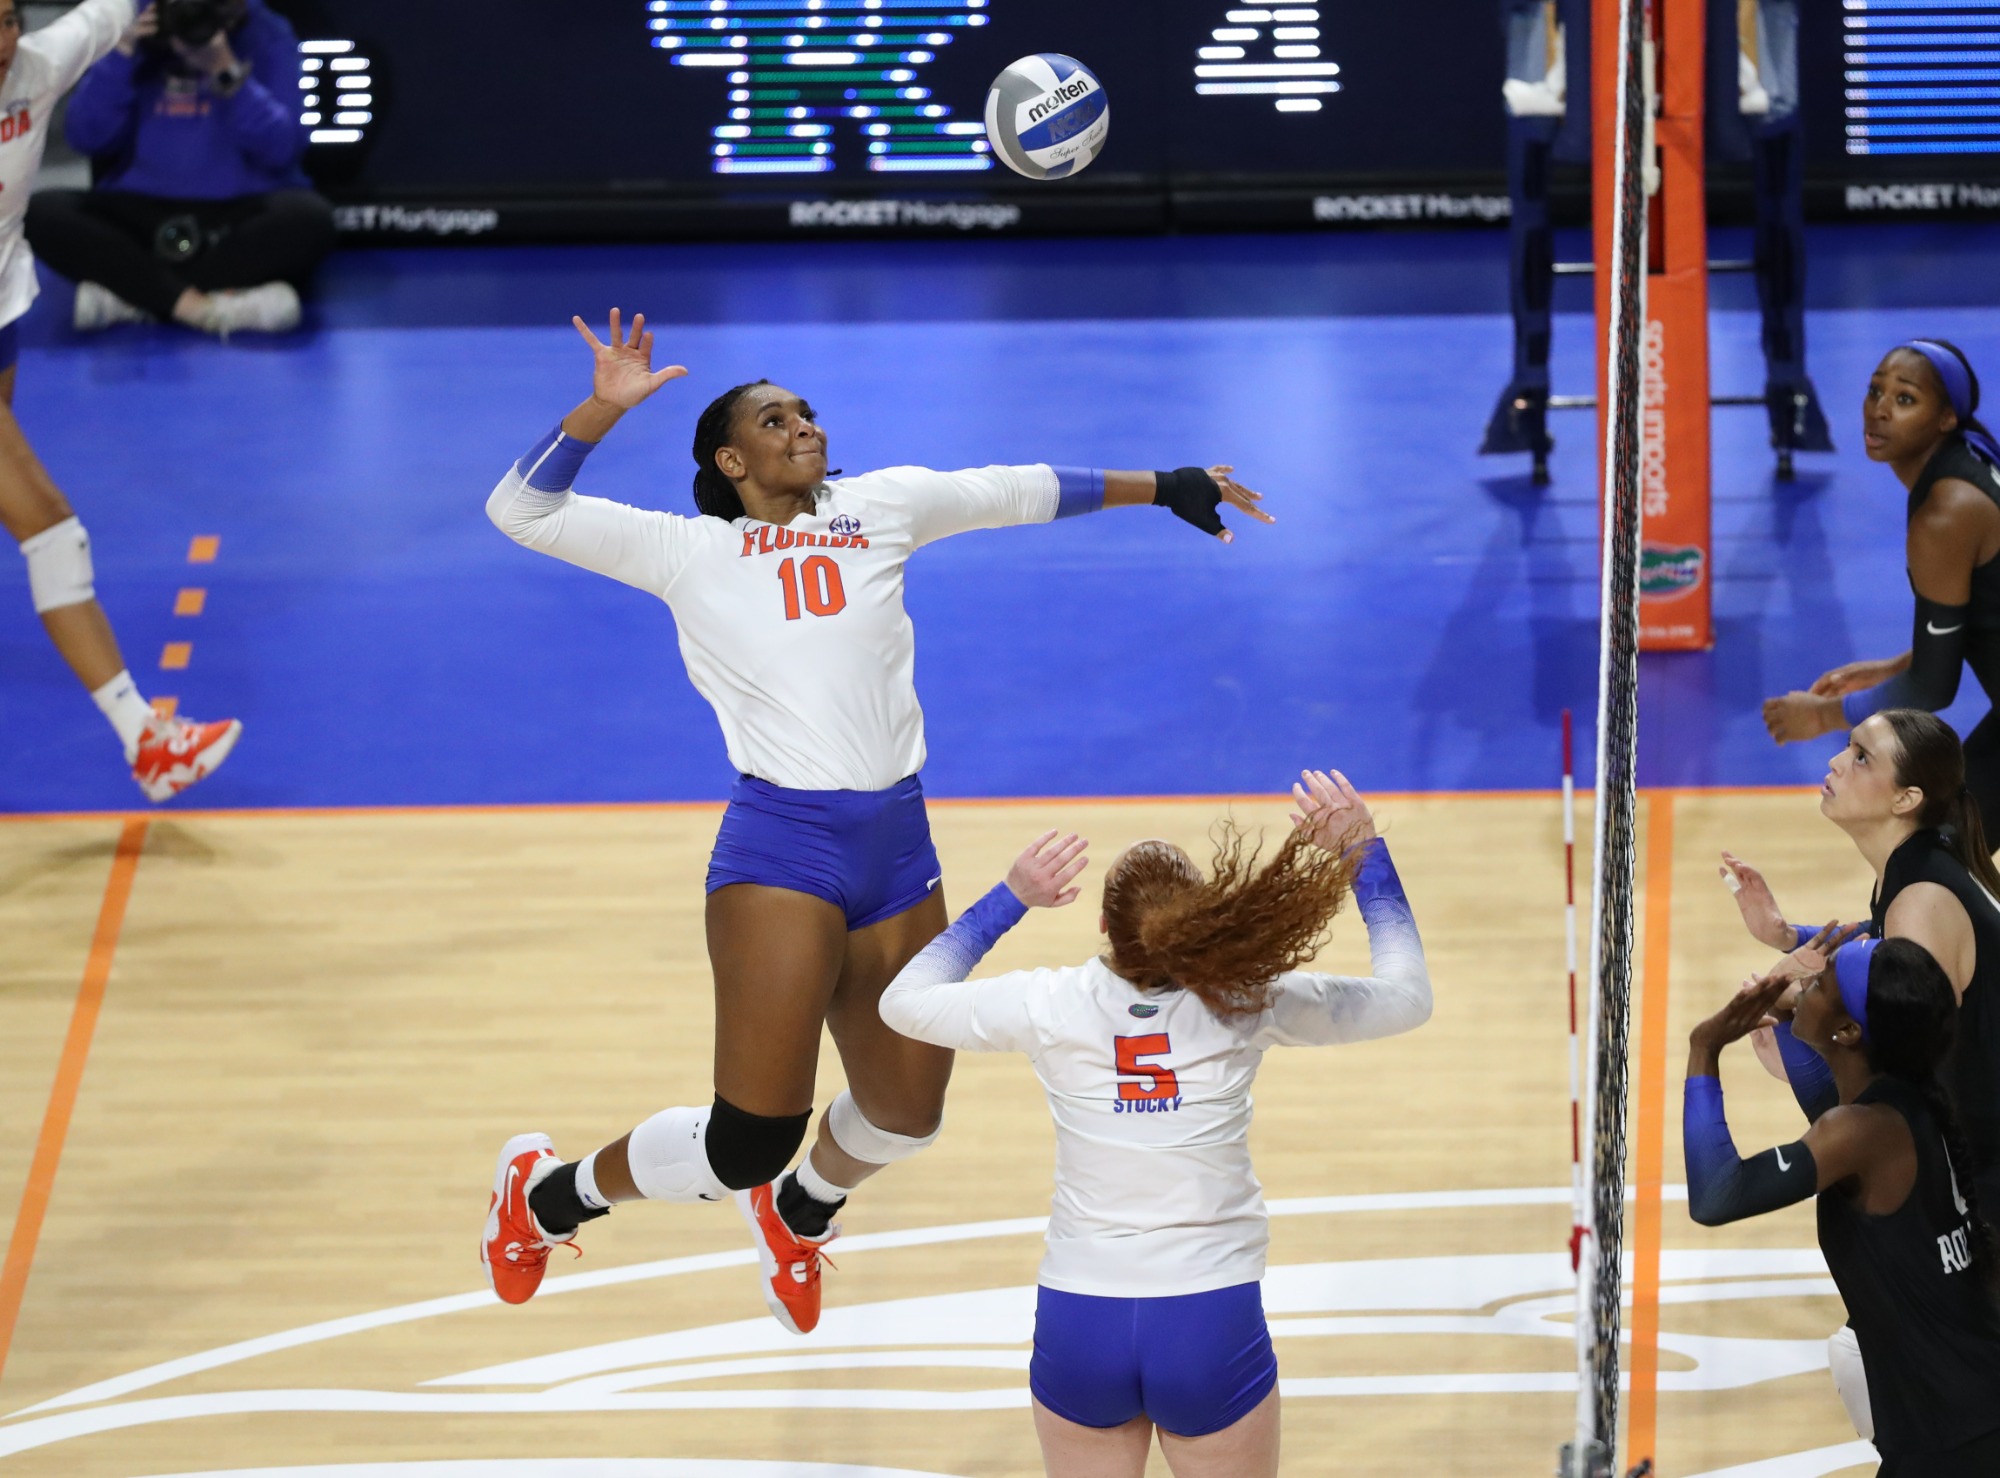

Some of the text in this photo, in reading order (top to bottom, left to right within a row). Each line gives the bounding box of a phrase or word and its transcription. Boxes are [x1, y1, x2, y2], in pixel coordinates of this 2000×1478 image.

[1028, 79, 1089, 122] molten
[1313, 195, 1422, 220] ROCKET
[1845, 184, 1953, 209] ROCKET
[379, 205, 498, 235] Mortgage
[790, 200, 1021, 230] ROCKET Mortgage
[829, 514, 861, 536] SEC
[777, 554, 847, 621] 10
[1114, 1032, 1180, 1100] 5
